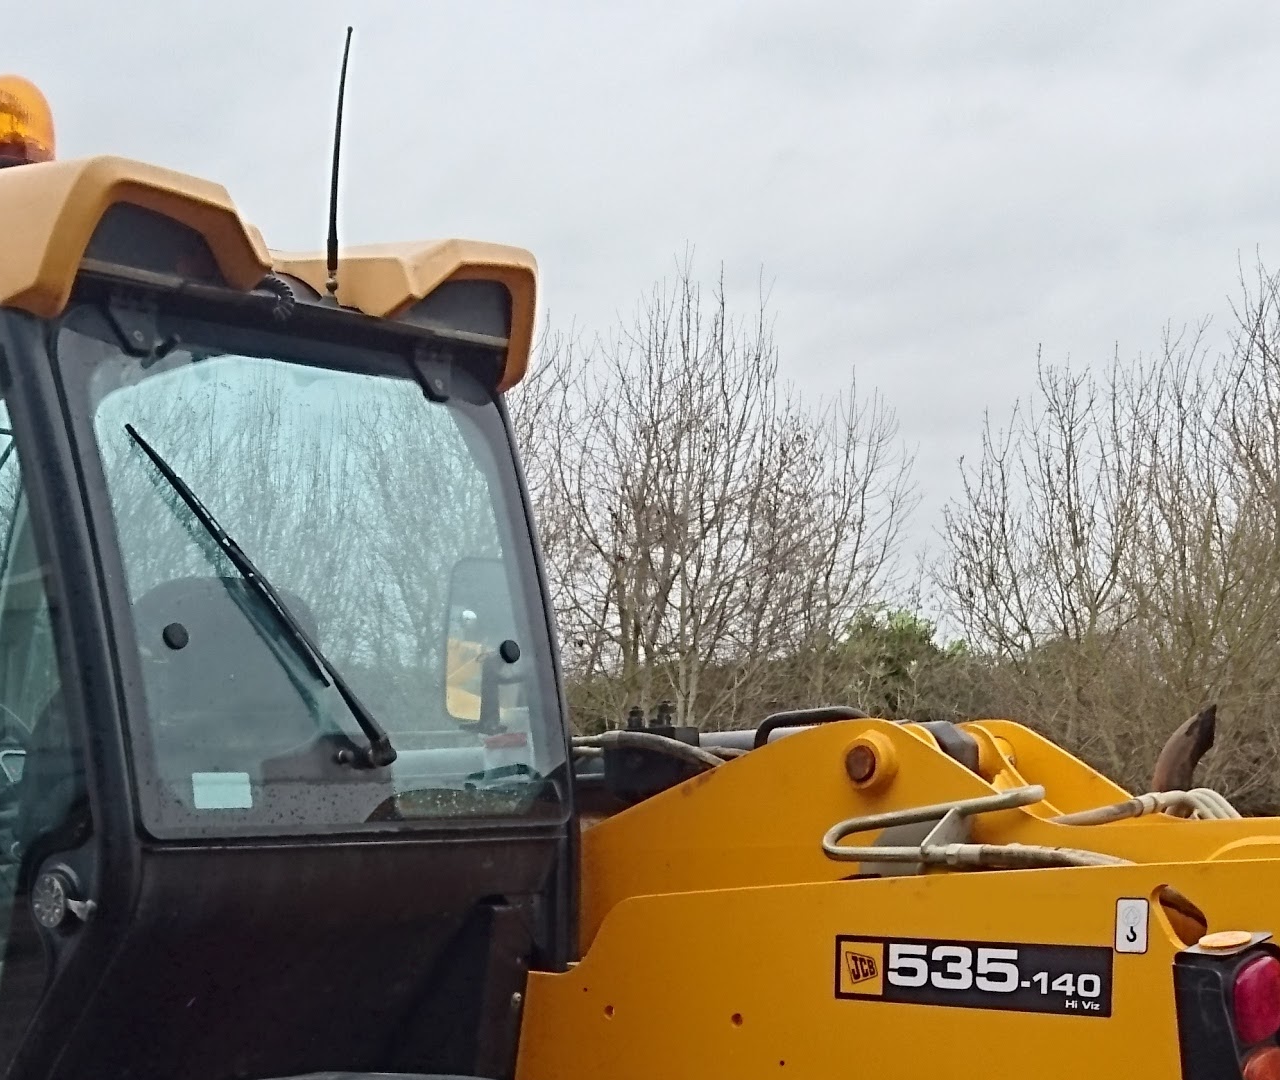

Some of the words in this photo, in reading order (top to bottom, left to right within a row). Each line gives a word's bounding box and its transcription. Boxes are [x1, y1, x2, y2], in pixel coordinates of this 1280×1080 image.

[851, 955, 876, 980] JCB
[1064, 999, 1078, 1009] Hi
[1081, 1000, 1100, 1011] Viz
